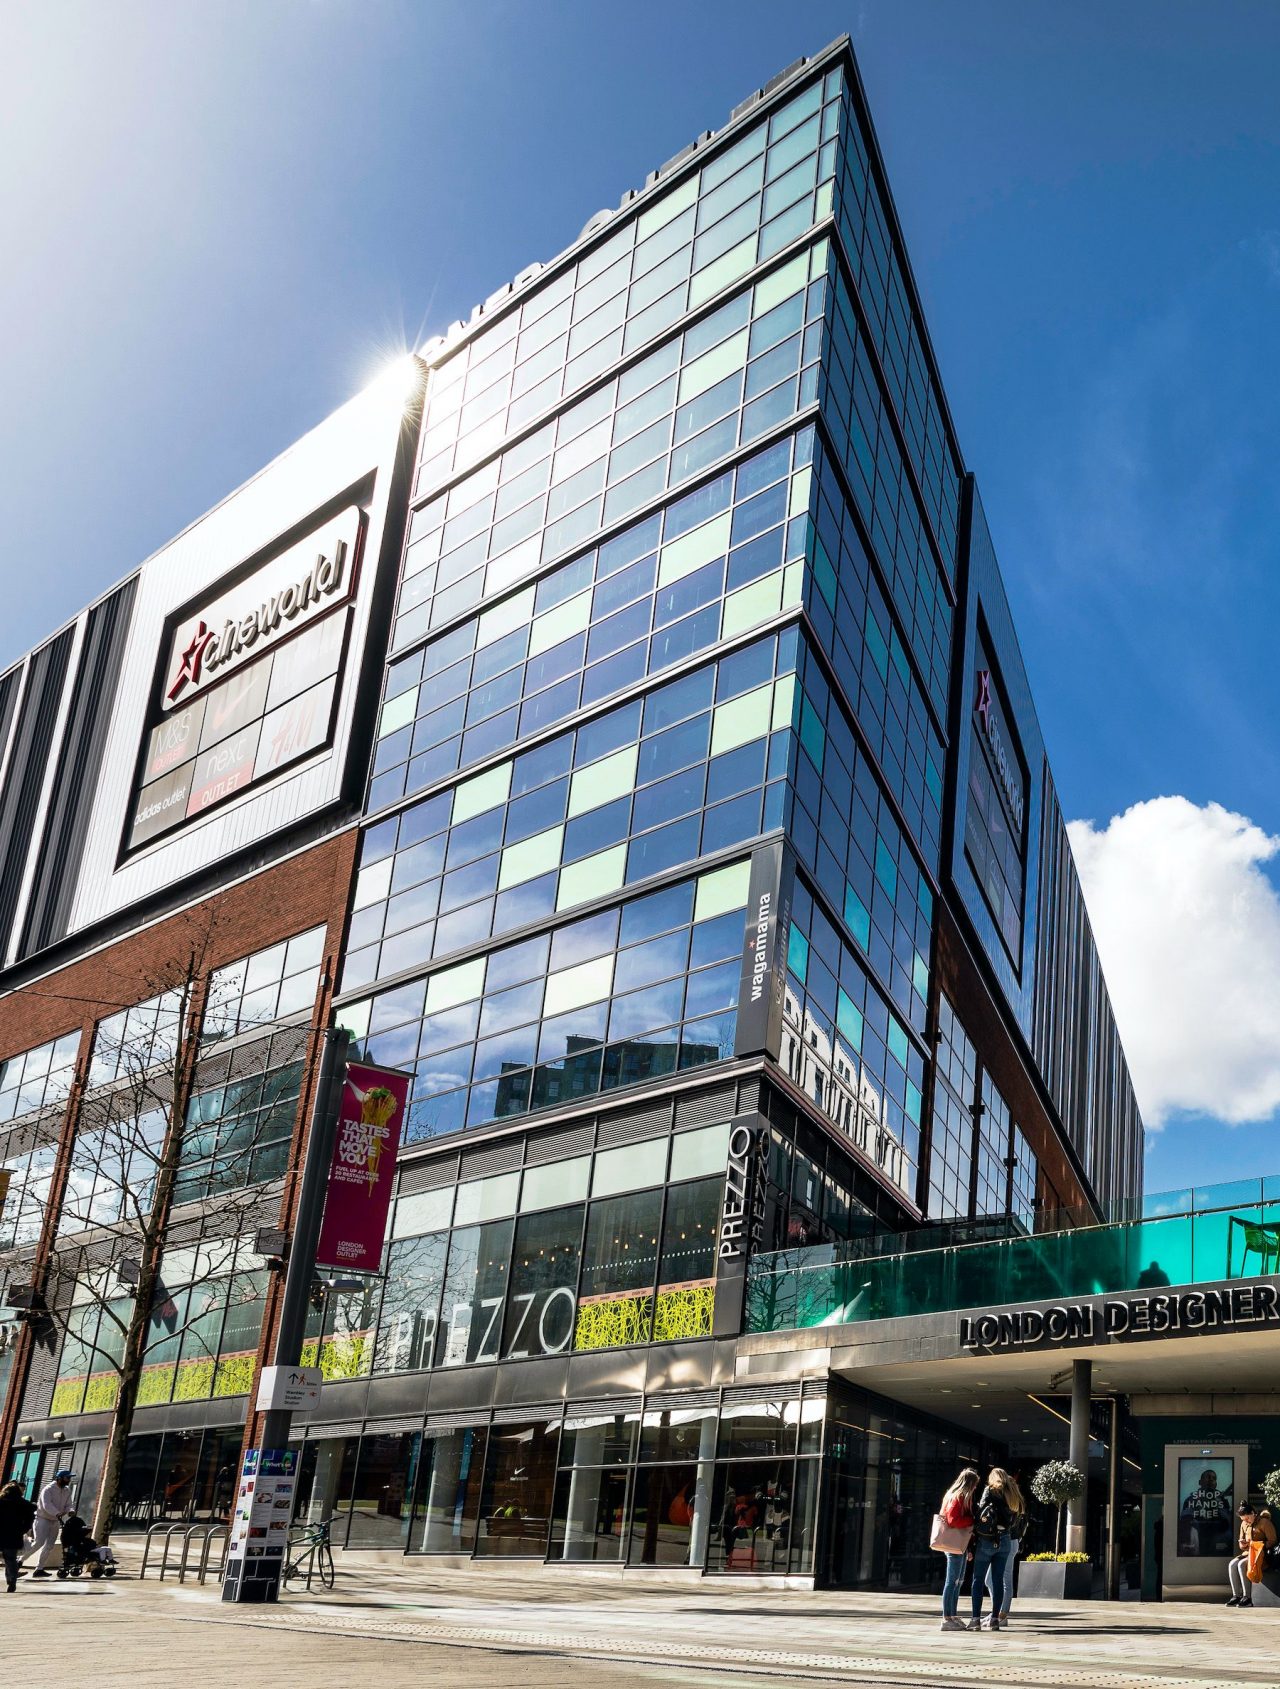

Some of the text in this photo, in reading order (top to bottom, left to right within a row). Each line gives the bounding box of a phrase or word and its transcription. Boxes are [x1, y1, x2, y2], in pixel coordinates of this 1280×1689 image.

[204, 539, 347, 672] cineworld
[206, 739, 247, 778] next
[201, 773, 240, 805] OUTLET
[134, 786, 186, 826] adidas outlet
[751, 892, 771, 1002] wagamama
[343, 1119, 390, 1138] TASTES
[343, 1130, 376, 1145] THAT
[339, 1140, 377, 1157] MOVE
[339, 1151, 367, 1165] YOU
[719, 1125, 751, 1258] PREZZO
[391, 1287, 577, 1373] PREZZO
[960, 1303, 1093, 1349] LONDON
[1104, 1285, 1280, 1336] DESIGNER
[1188, 1500, 1224, 1509] HANDS
[1192, 1490, 1220, 1500] SHOP
[1193, 1508, 1219, 1519] FREE
